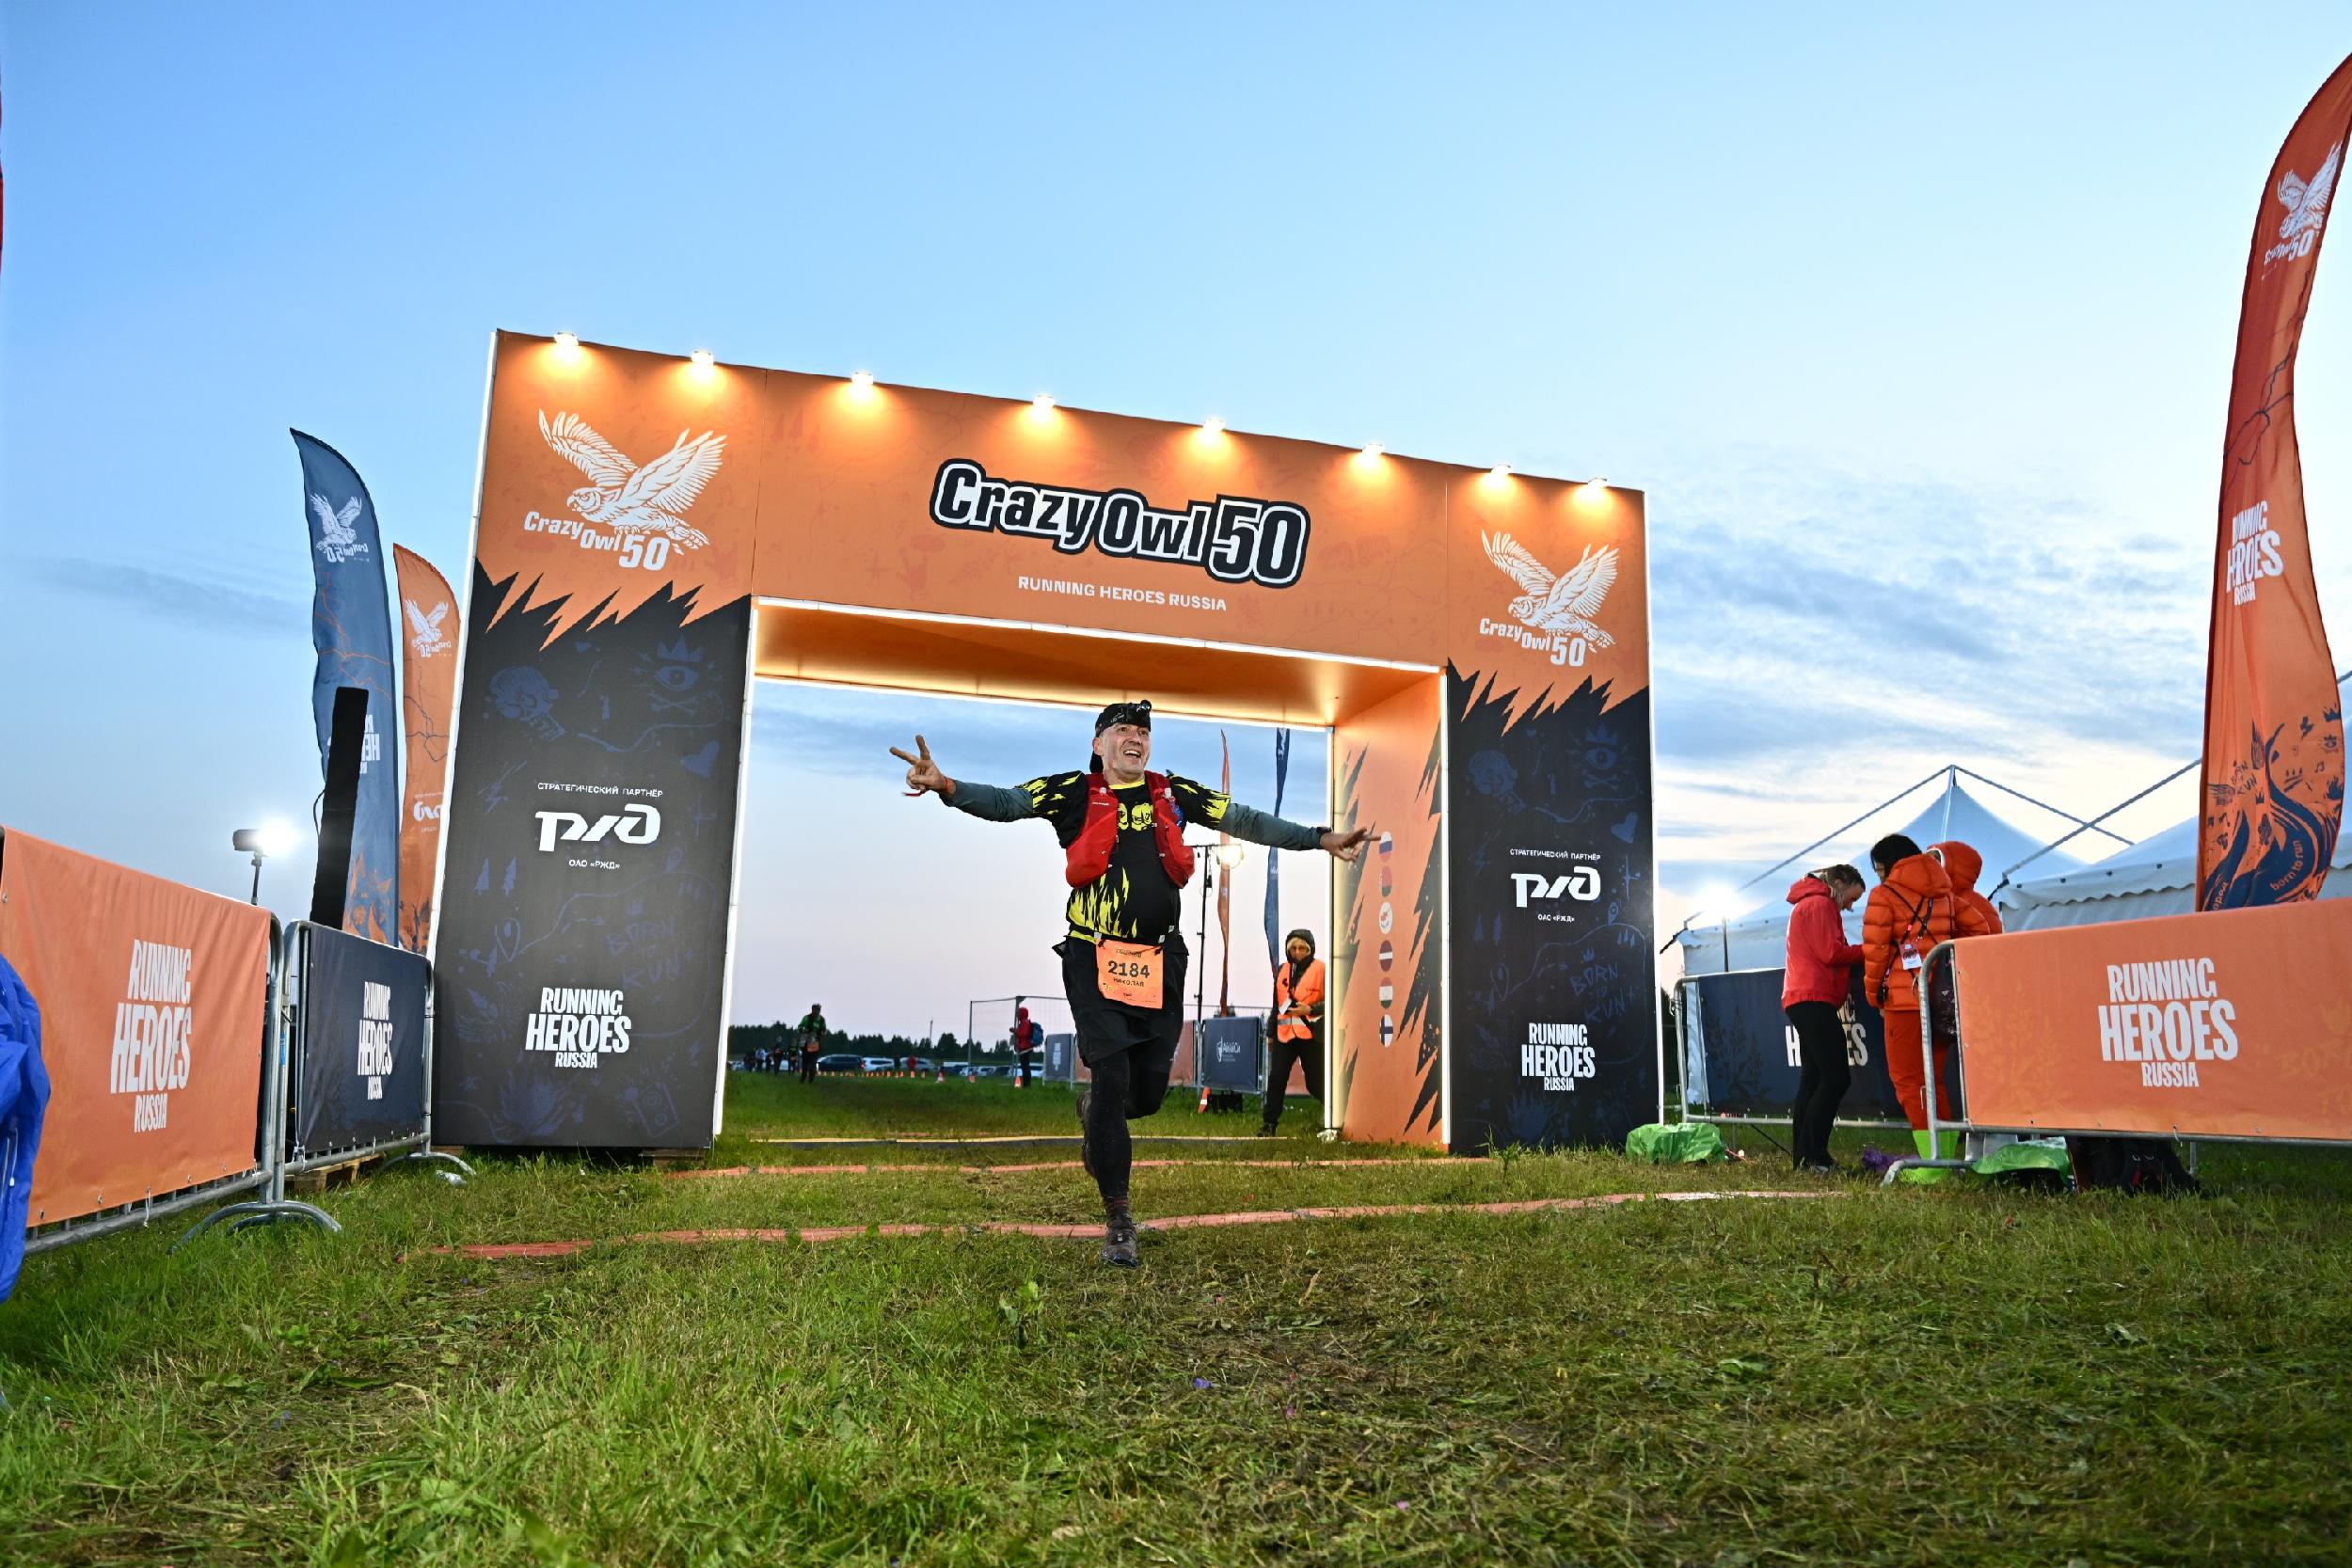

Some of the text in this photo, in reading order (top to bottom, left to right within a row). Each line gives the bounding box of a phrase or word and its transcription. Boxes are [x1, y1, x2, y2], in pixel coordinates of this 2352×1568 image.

[1018, 576, 1227, 611] RUNNING HEROES RUSSIA
[537, 782, 663, 798] СТРАТЕГИЧЕСКИЙ ПАРТНЁР
[128, 939, 192, 1005] RUNNING
[1107, 959, 1151, 979] 2184
[2106, 958, 2217, 1003] RUNNING
[540, 987, 624, 1016] RUNNING
[110, 1002, 192, 1094] HEROES
[358, 1019, 393, 1076] HEROES
[525, 1013, 631, 1053] HEROES
[1529, 1022, 1588, 1046] RUNNING
[1785, 1022, 1868, 1067] HES
[2098, 1000, 2239, 1062] HEROES
[554, 1052, 598, 1069] RUSSIA
[1521, 1043, 1596, 1079] HEROES
[2141, 1061, 2200, 1088] RUSSIA
[1544, 1076, 1575, 1092] RUSSIA
[134, 1093, 167, 1133] RUSSIA
